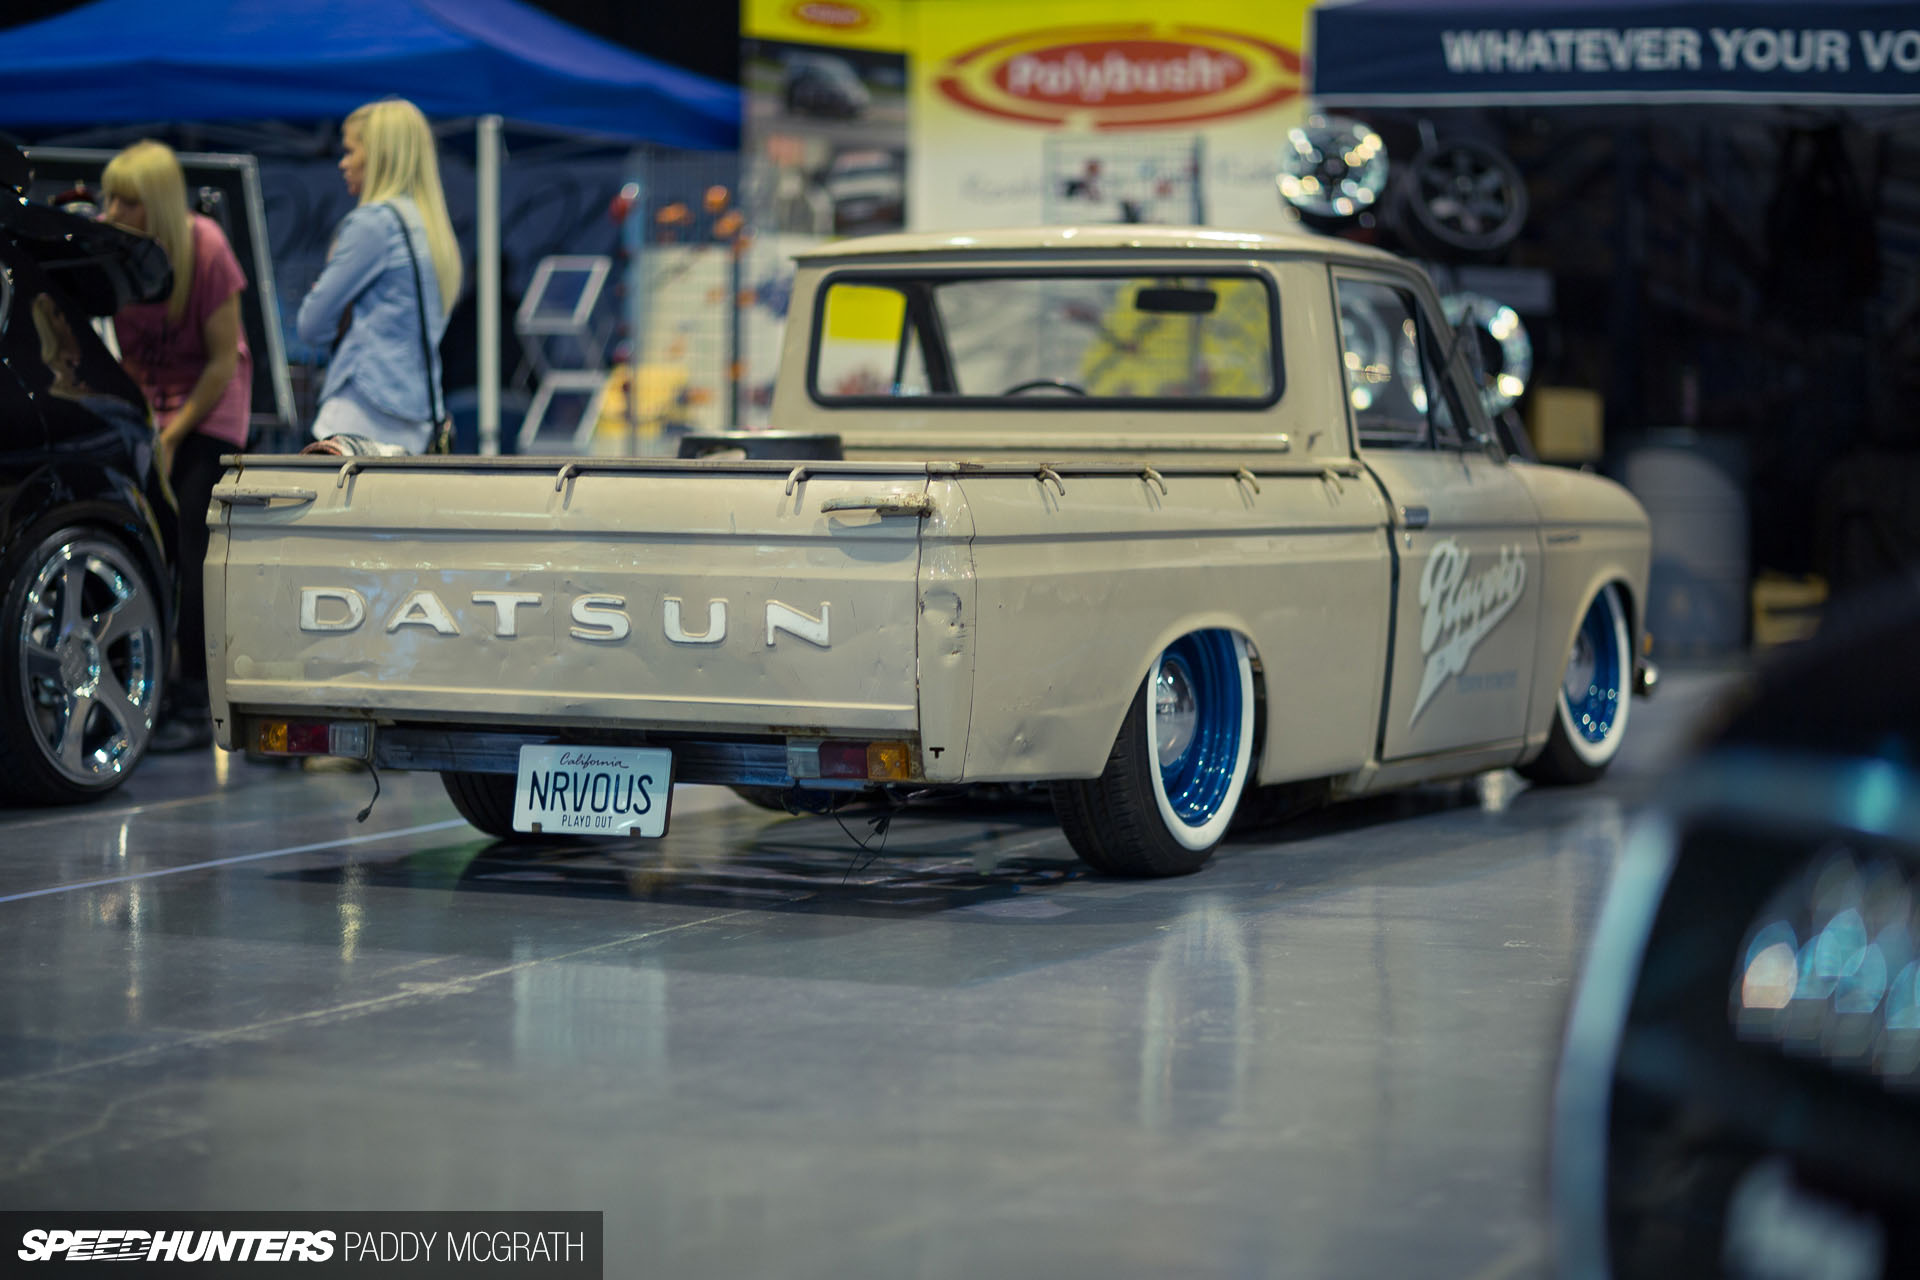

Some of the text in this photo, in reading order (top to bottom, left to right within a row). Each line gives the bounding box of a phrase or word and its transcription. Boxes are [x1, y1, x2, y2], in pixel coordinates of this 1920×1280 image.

[1441, 28, 1702, 73] WHATEVER
[1710, 28, 1850, 72] YOUR
[299, 586, 832, 649] DATSUN
[559, 751, 630, 770] California
[528, 770, 654, 815] NRVOUS
[561, 814, 613, 829] PLAYD OUT
